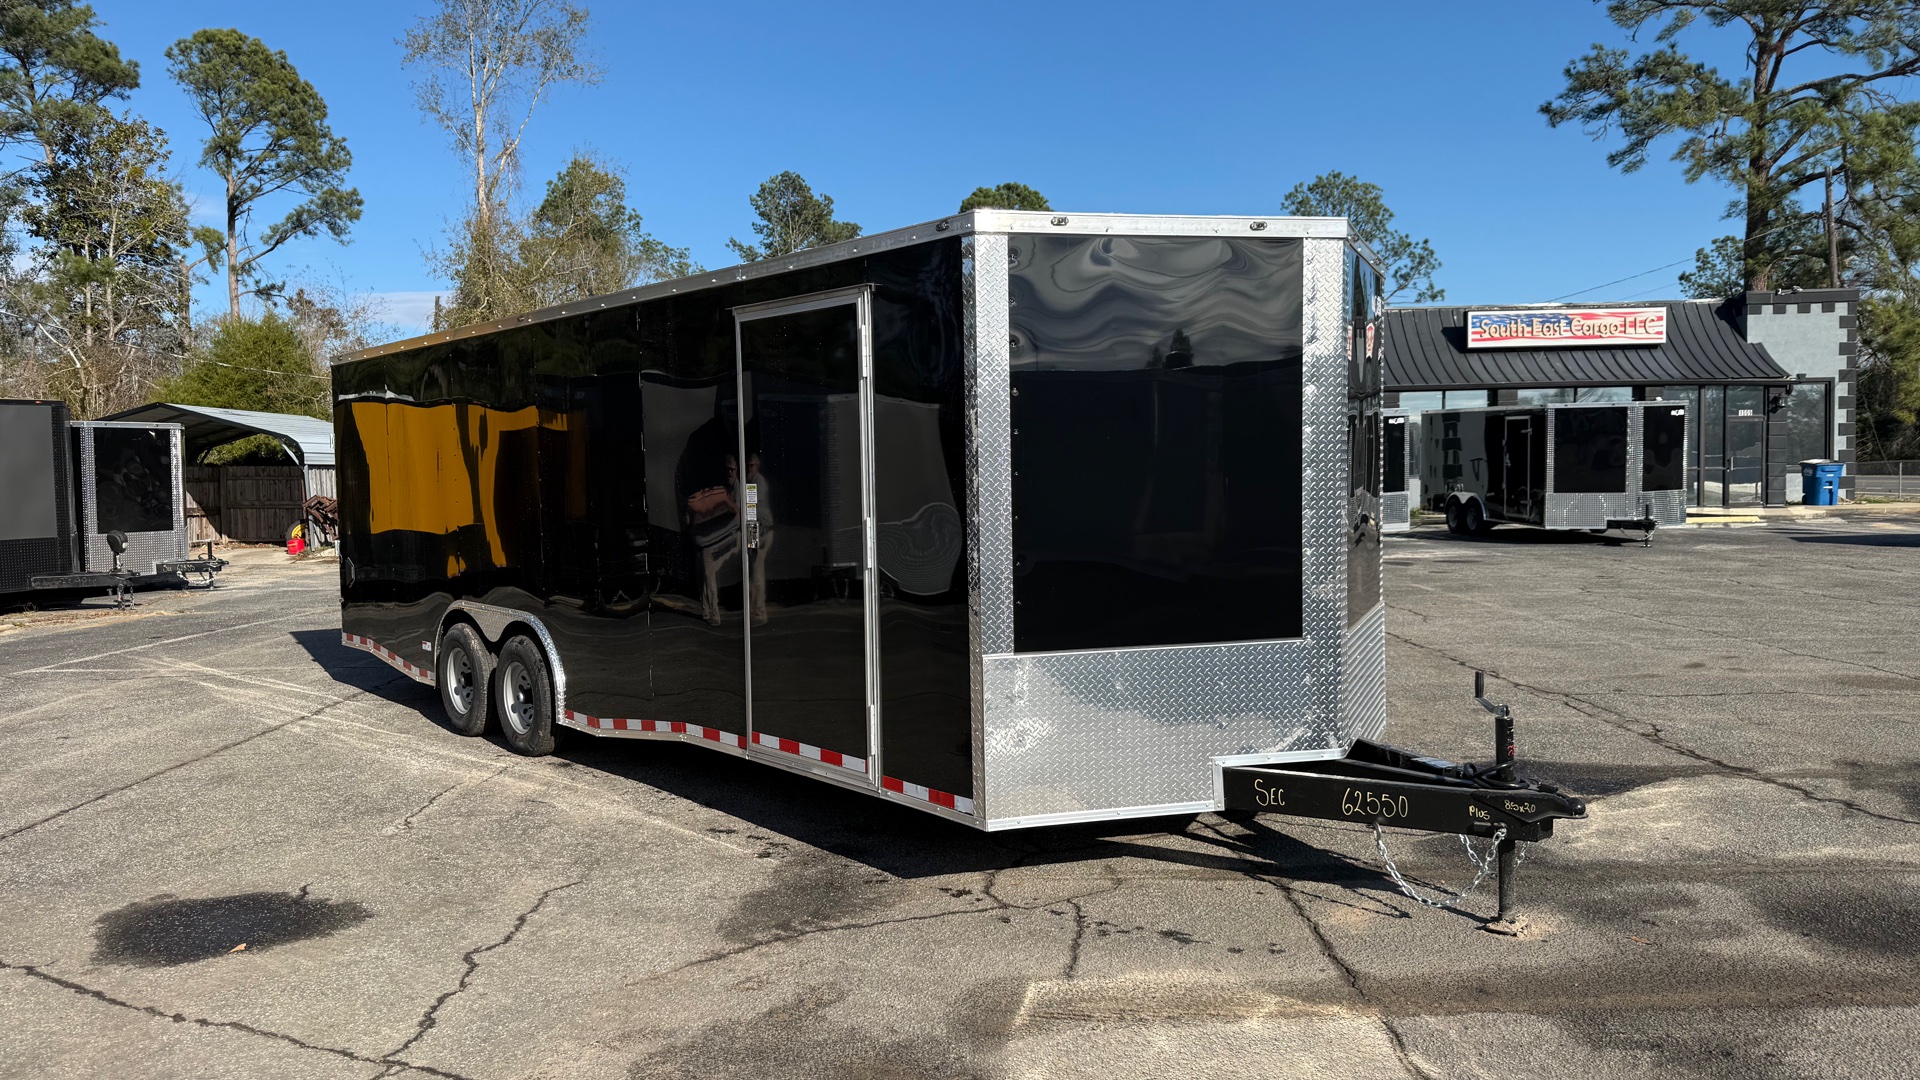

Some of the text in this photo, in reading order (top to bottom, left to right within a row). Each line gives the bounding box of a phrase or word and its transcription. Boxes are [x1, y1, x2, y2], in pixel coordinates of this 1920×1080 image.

[1480, 316, 1657, 337] South East Cargo LLC
[1342, 787, 1408, 818] 62550
